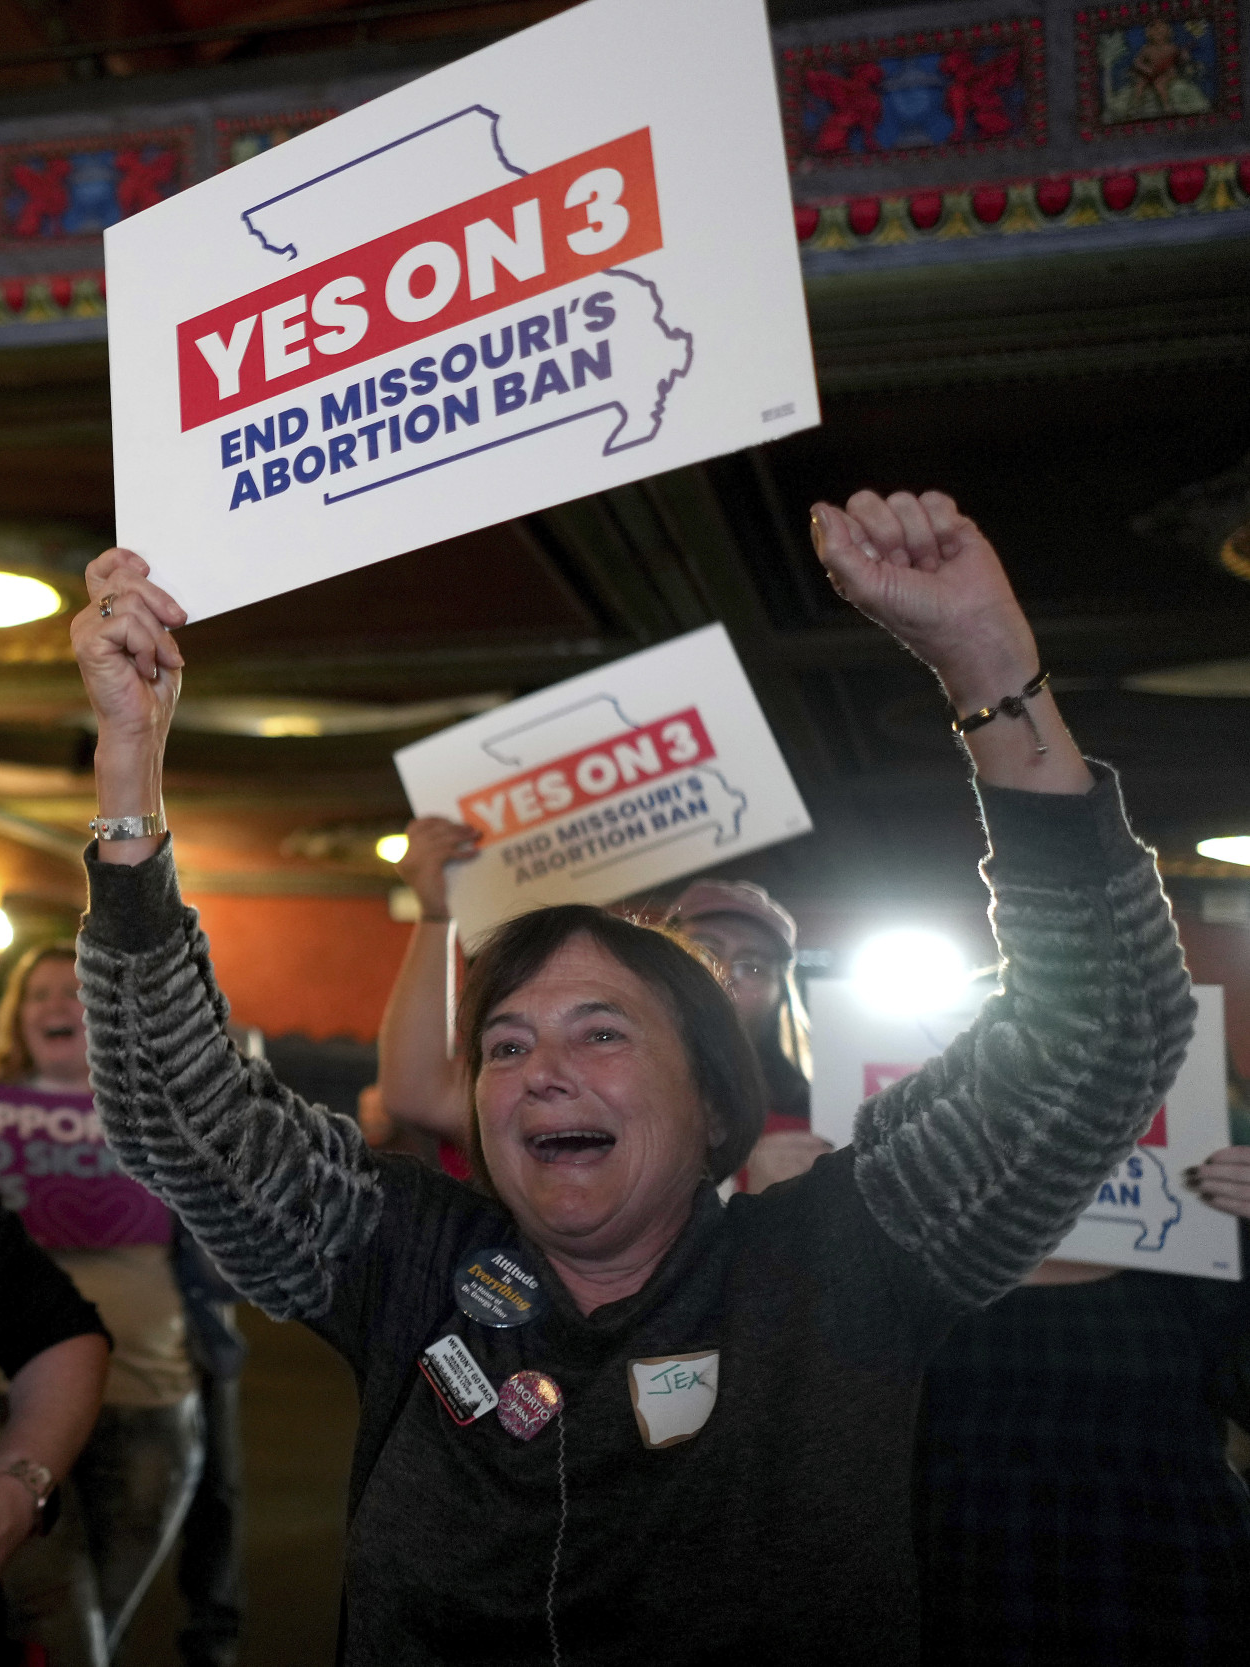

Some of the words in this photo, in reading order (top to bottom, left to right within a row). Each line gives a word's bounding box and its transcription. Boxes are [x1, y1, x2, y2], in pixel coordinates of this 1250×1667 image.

[195, 274, 369, 400] YES
[384, 196, 547, 323] ON
[563, 167, 631, 256] 3
[219, 405, 309, 470] END
[320, 290, 616, 433] MISSOURI'S
[228, 385, 479, 511] ABORTION
[493, 339, 613, 417] BAN
[471, 770, 574, 834] YES
[576, 733, 662, 795] ON
[661, 720, 699, 764] 3
[501, 835, 552, 867] END
[556, 775, 703, 844] MISSOURI'S
[516, 821, 646, 887] ABORTION
[651, 797, 709, 831] BAN
[1098, 1182, 1141, 1207] AN
[467, 1264, 531, 1311] Everything
[491, 1253, 538, 1289] Attitude
[501, 1274, 512, 1284] is
[448, 1337, 458, 1351] WE
[456, 1349, 474, 1373] WON'T
[471, 1373, 481, 1384] GO
[478, 1384, 493, 1403] BACK
[509, 1379, 550, 1420] ABORTIO
